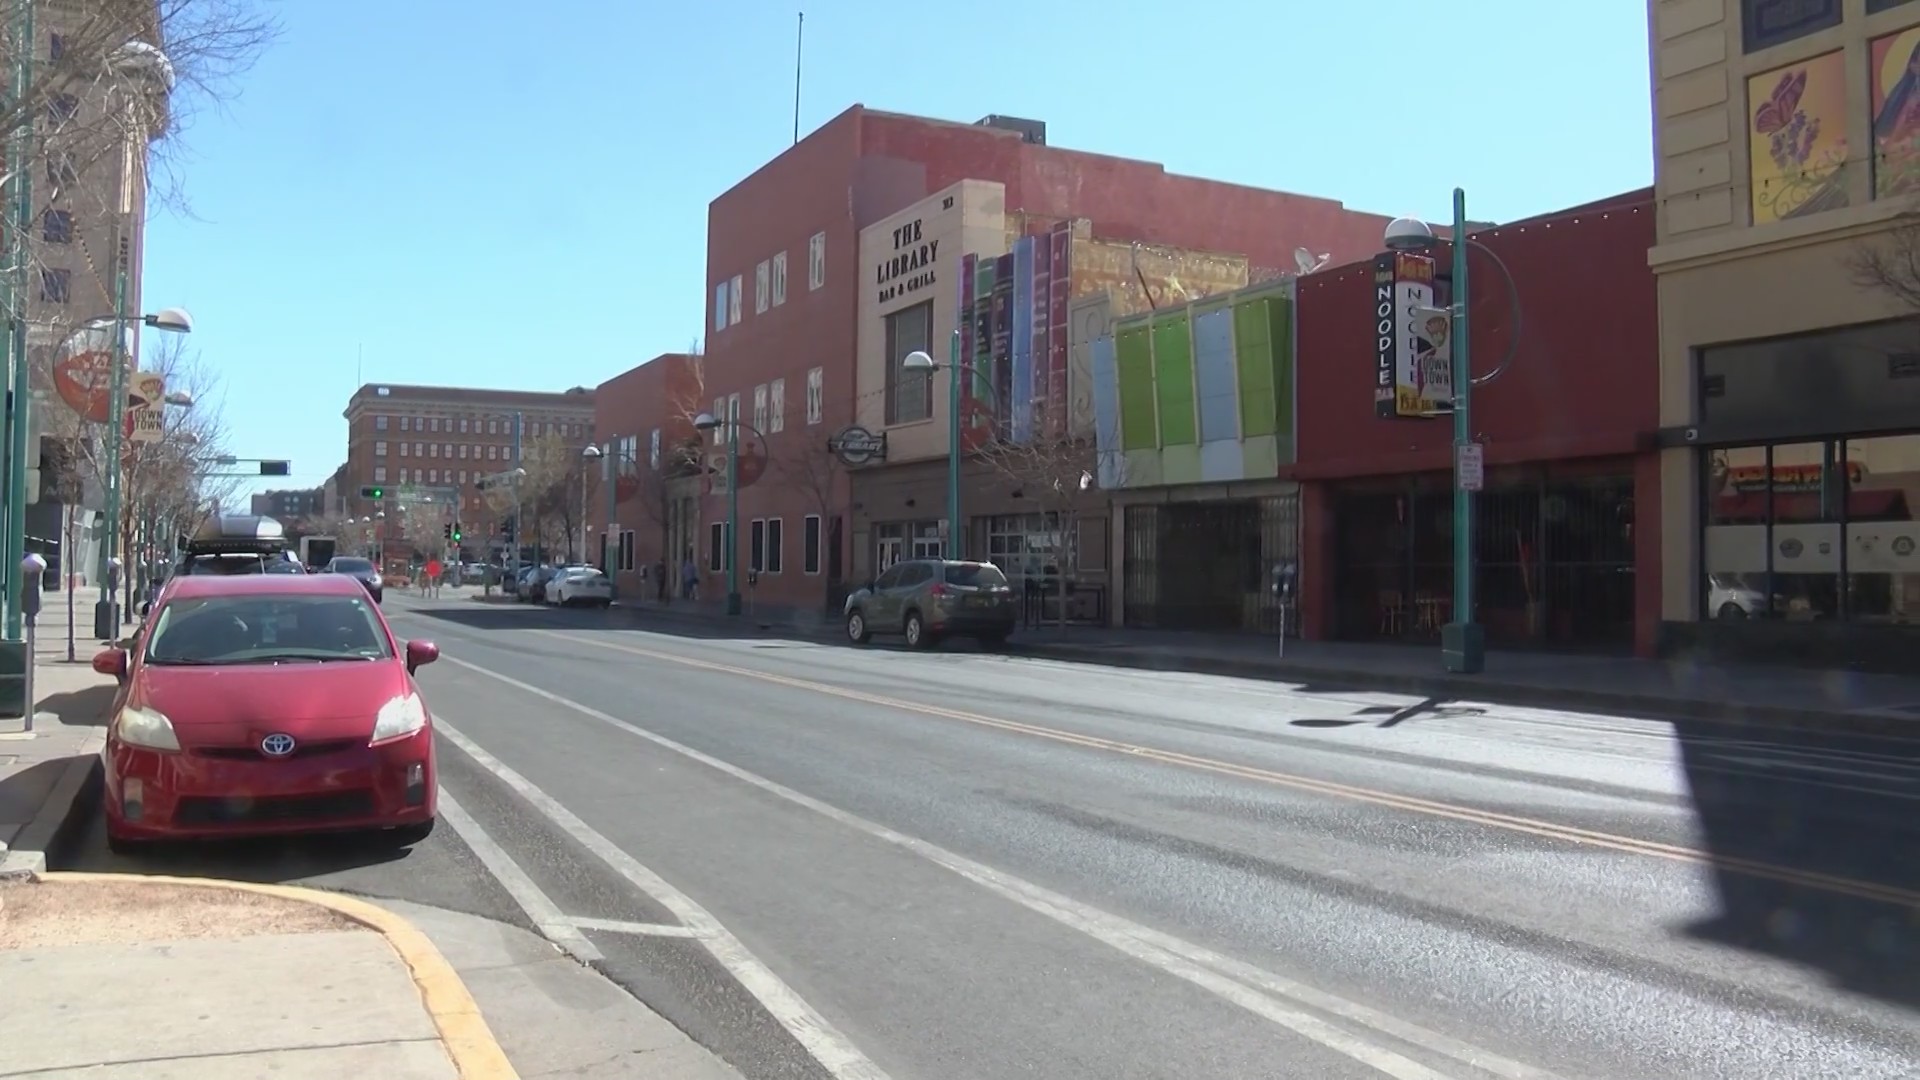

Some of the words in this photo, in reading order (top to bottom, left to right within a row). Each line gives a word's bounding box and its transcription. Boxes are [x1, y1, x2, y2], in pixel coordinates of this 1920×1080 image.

[893, 219, 922, 250] THE
[877, 240, 939, 285] LIBRARY
[879, 286, 896, 303] BAR
[907, 270, 936, 293] GRILL
[1377, 285, 1392, 385] NOODLE
[1423, 358, 1449, 371] DOWN
[1424, 372, 1450, 385] TOWN
[134, 409, 163, 420] DOWN
[134, 419, 162, 430] TOWN
